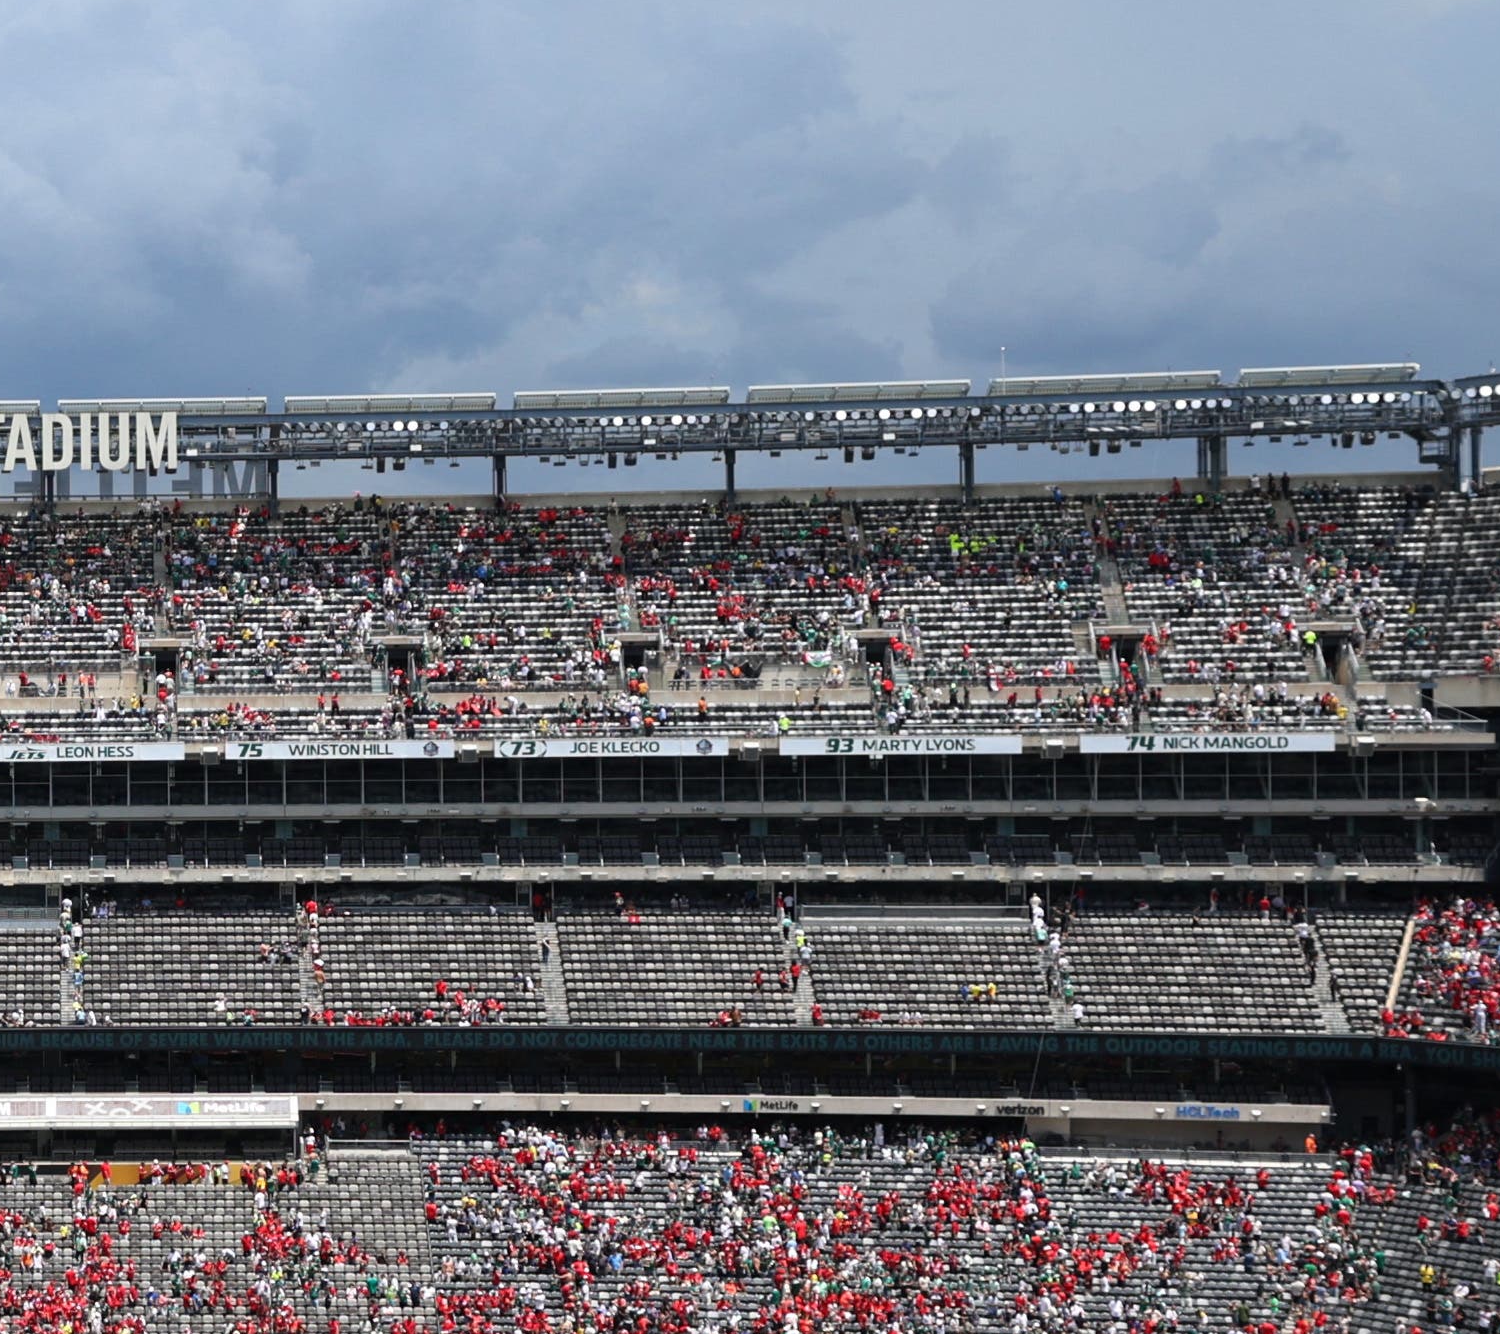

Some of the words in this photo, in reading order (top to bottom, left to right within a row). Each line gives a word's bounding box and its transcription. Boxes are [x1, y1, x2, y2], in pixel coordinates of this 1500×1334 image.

[237, 743, 263, 757] 75
[288, 744, 360, 756] WINSTON
[363, 743, 394, 755] HILL
[511, 741, 537, 755] 73
[570, 741, 599, 754] JOE
[601, 741, 660, 753] KLECKO
[826, 738, 854, 753] 93
[862, 739, 922, 751] MARTY
[926, 738, 976, 751] LYONS
[1126, 736, 1155, 750] 74
[1163, 738, 1198, 749] NICK
[1203, 736, 1289, 749] MANGOLD
[5, 749, 47, 760] JETS
[57, 747, 94, 759] LEON
[97, 746, 135, 758] HESS
[204, 1101, 266, 1114] MetLife
[760, 1099, 798, 1111] MetLife
[996, 1103, 1044, 1115] verizon
[1176, 1105, 1239, 1118] HCLTech
